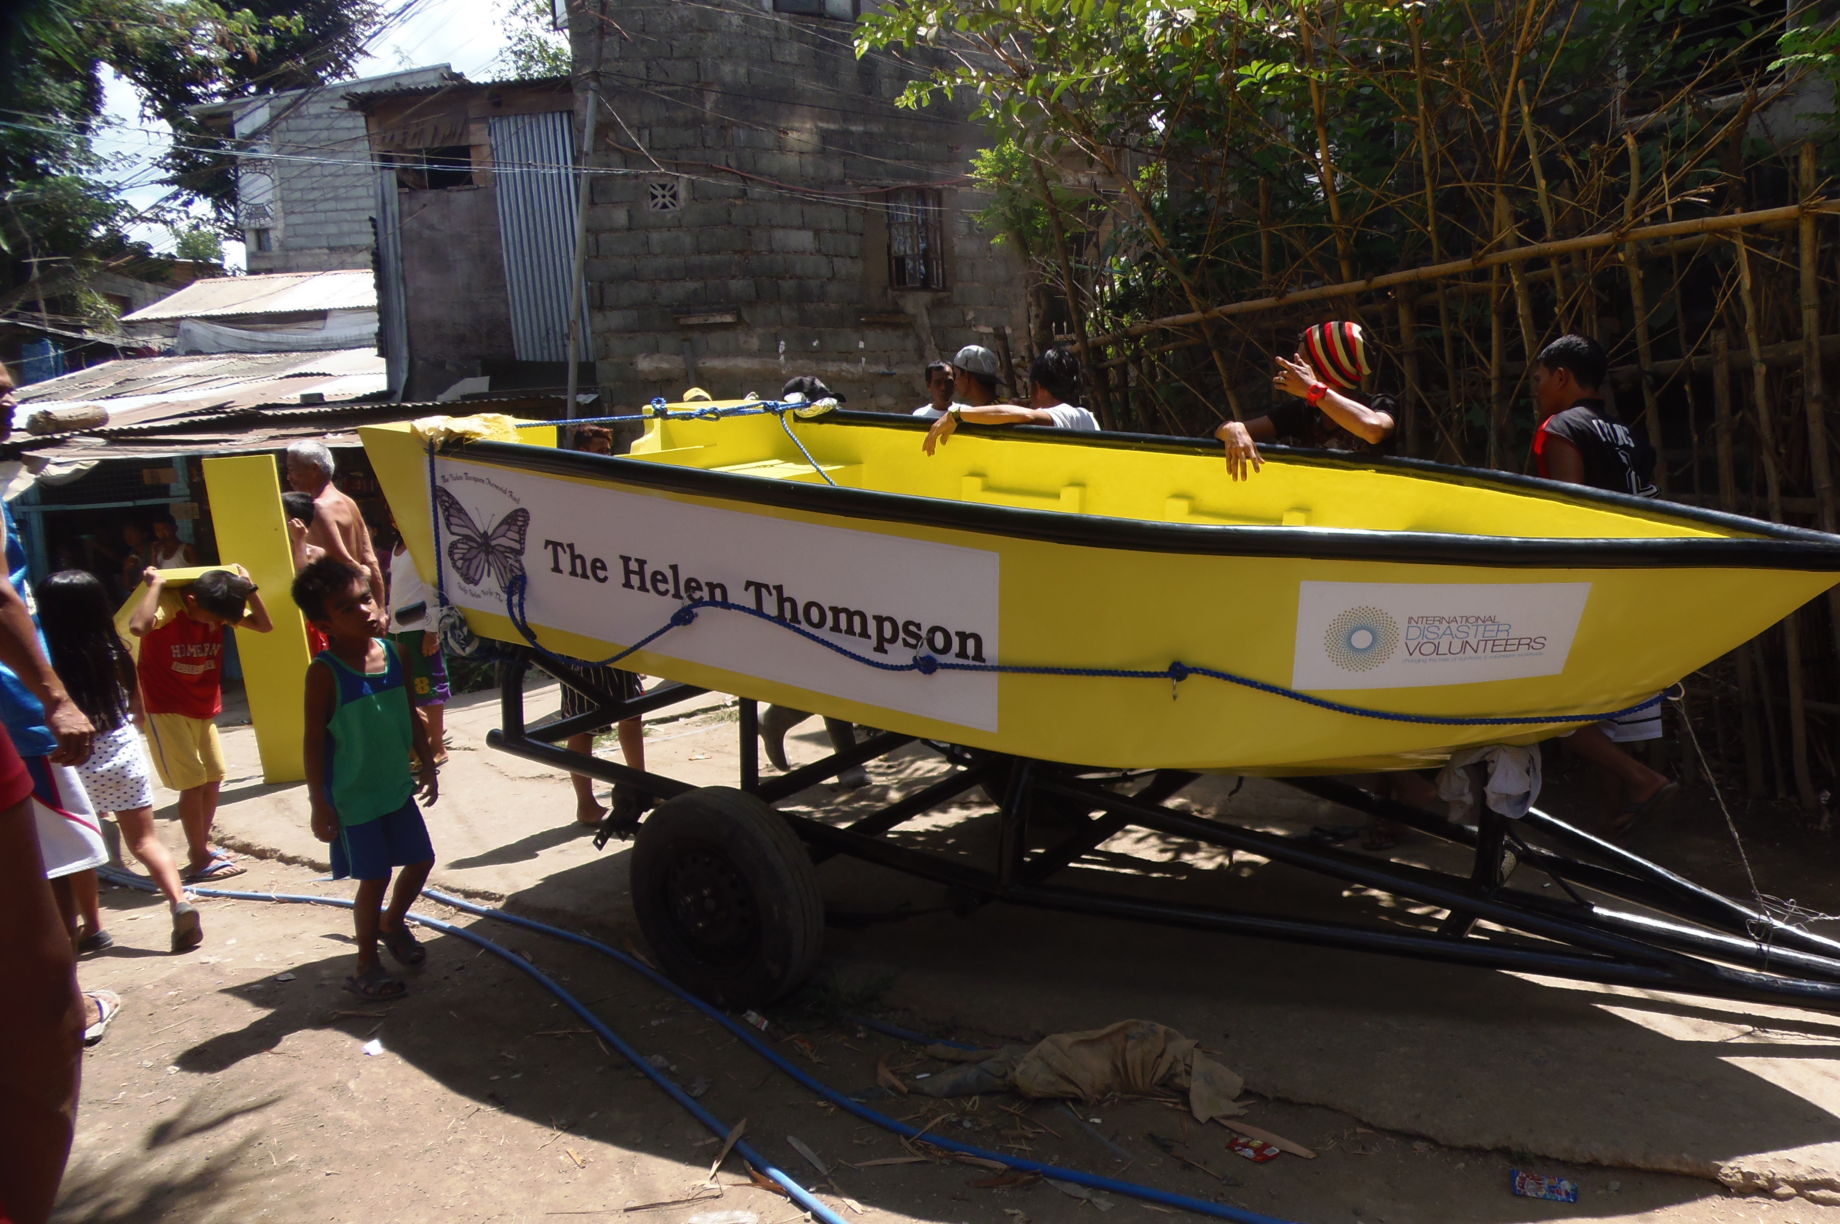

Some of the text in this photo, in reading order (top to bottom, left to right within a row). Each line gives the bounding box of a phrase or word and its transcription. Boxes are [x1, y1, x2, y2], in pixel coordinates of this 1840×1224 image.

[544, 539, 986, 663] The Helen Thompson
[1407, 615, 1500, 625] INTERNATIONAL
[1405, 623, 1512, 641] DISASTER
[1404, 636, 1547, 656] VOLUNTEERS
